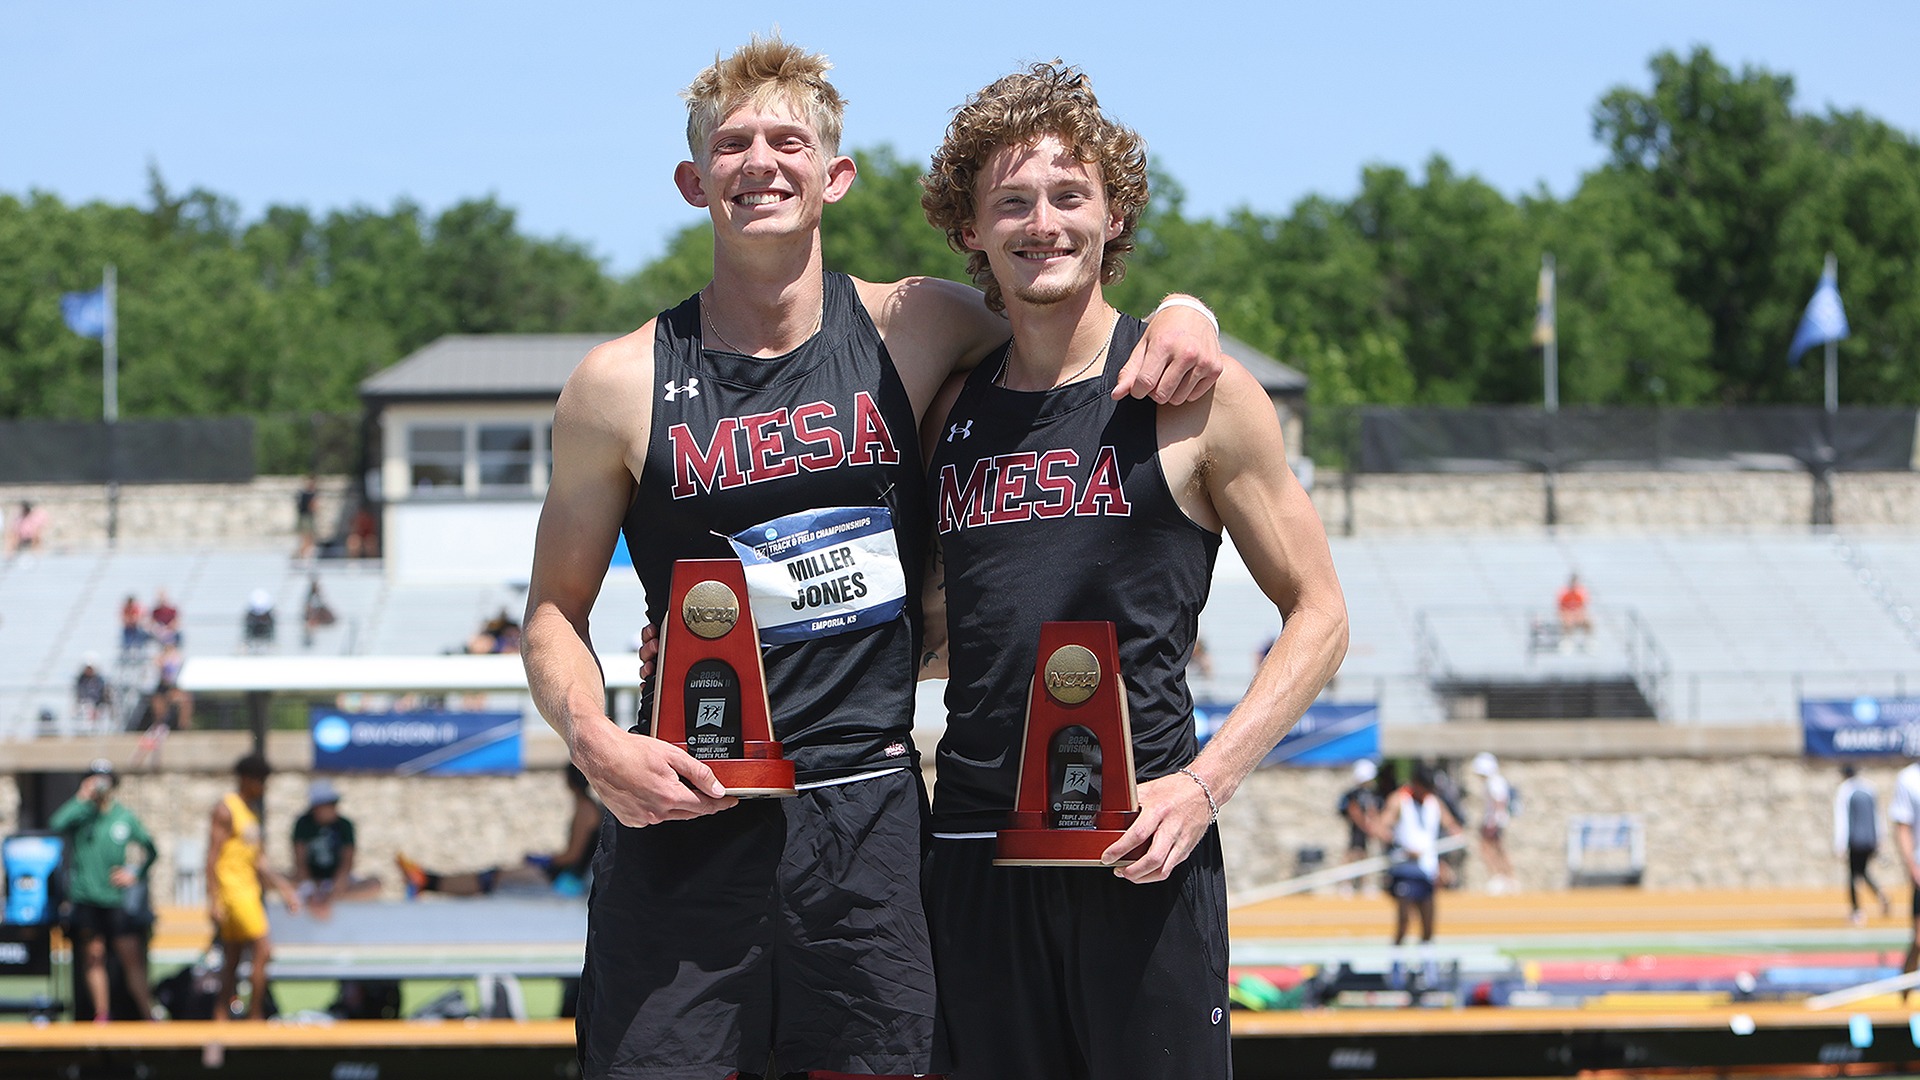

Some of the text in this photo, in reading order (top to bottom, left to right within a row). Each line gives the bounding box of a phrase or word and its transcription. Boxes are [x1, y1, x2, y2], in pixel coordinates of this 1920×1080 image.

[668, 391, 900, 500] MESA
[937, 445, 1132, 535] MESA
[768, 539, 792, 554] TRACK
[798, 532, 815, 545] FIELD
[815, 517, 871, 539] CHAMPIONSHIPS
[787, 546, 856, 582] MILLER
[791, 571, 868, 610] JONES
[686, 606, 737, 625] NCAA
[811, 615, 857, 631] EMPORIA, KS
[690, 679, 723, 688] DIVISION
[1048, 671, 1097, 688] NCAA
[697, 736, 715, 744] TRACK
[1058, 744, 1091, 753] DIVISION
[1068, 736, 1089, 744] 2024
[1062, 803, 1080, 811] TRACK
